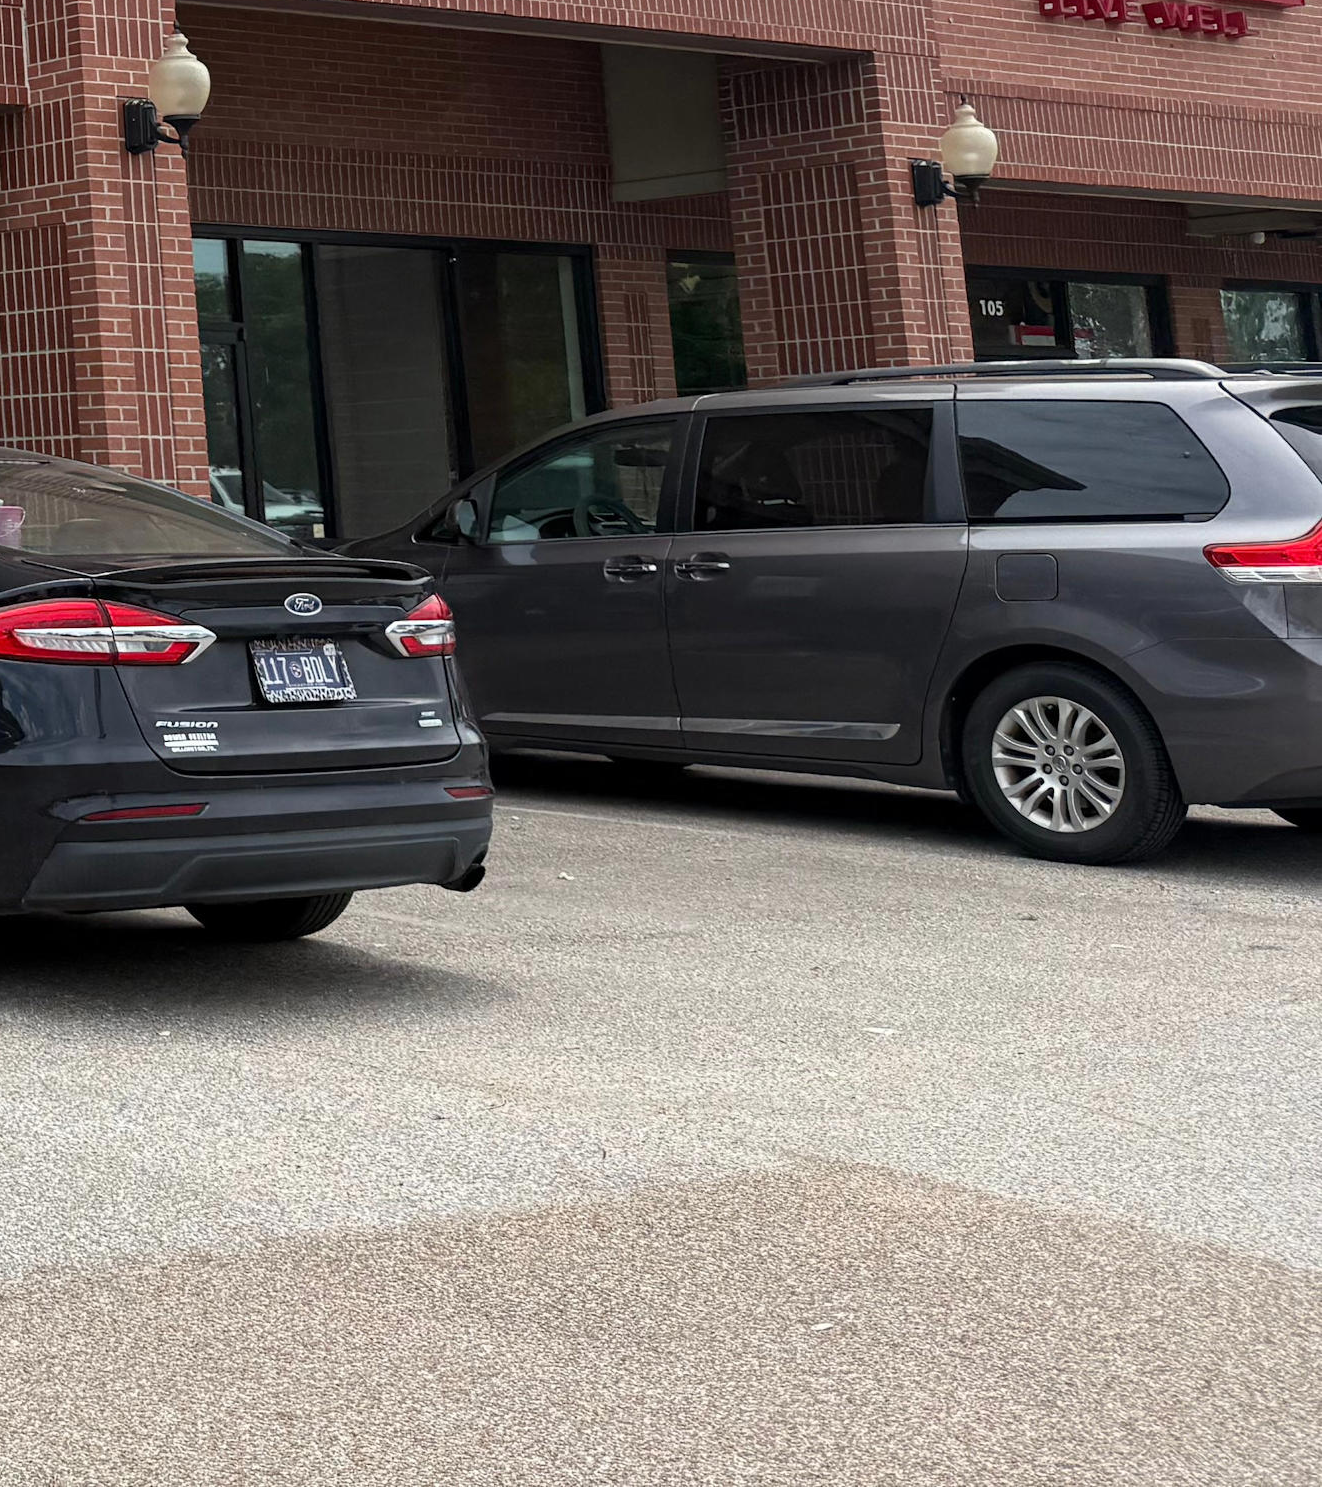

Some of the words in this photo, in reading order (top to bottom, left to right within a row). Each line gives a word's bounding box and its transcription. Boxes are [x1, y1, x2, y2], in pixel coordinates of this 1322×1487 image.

[979, 299, 1004, 316] 105
[260, 656, 291, 686] 117
[300, 656, 340, 684] BDLY
